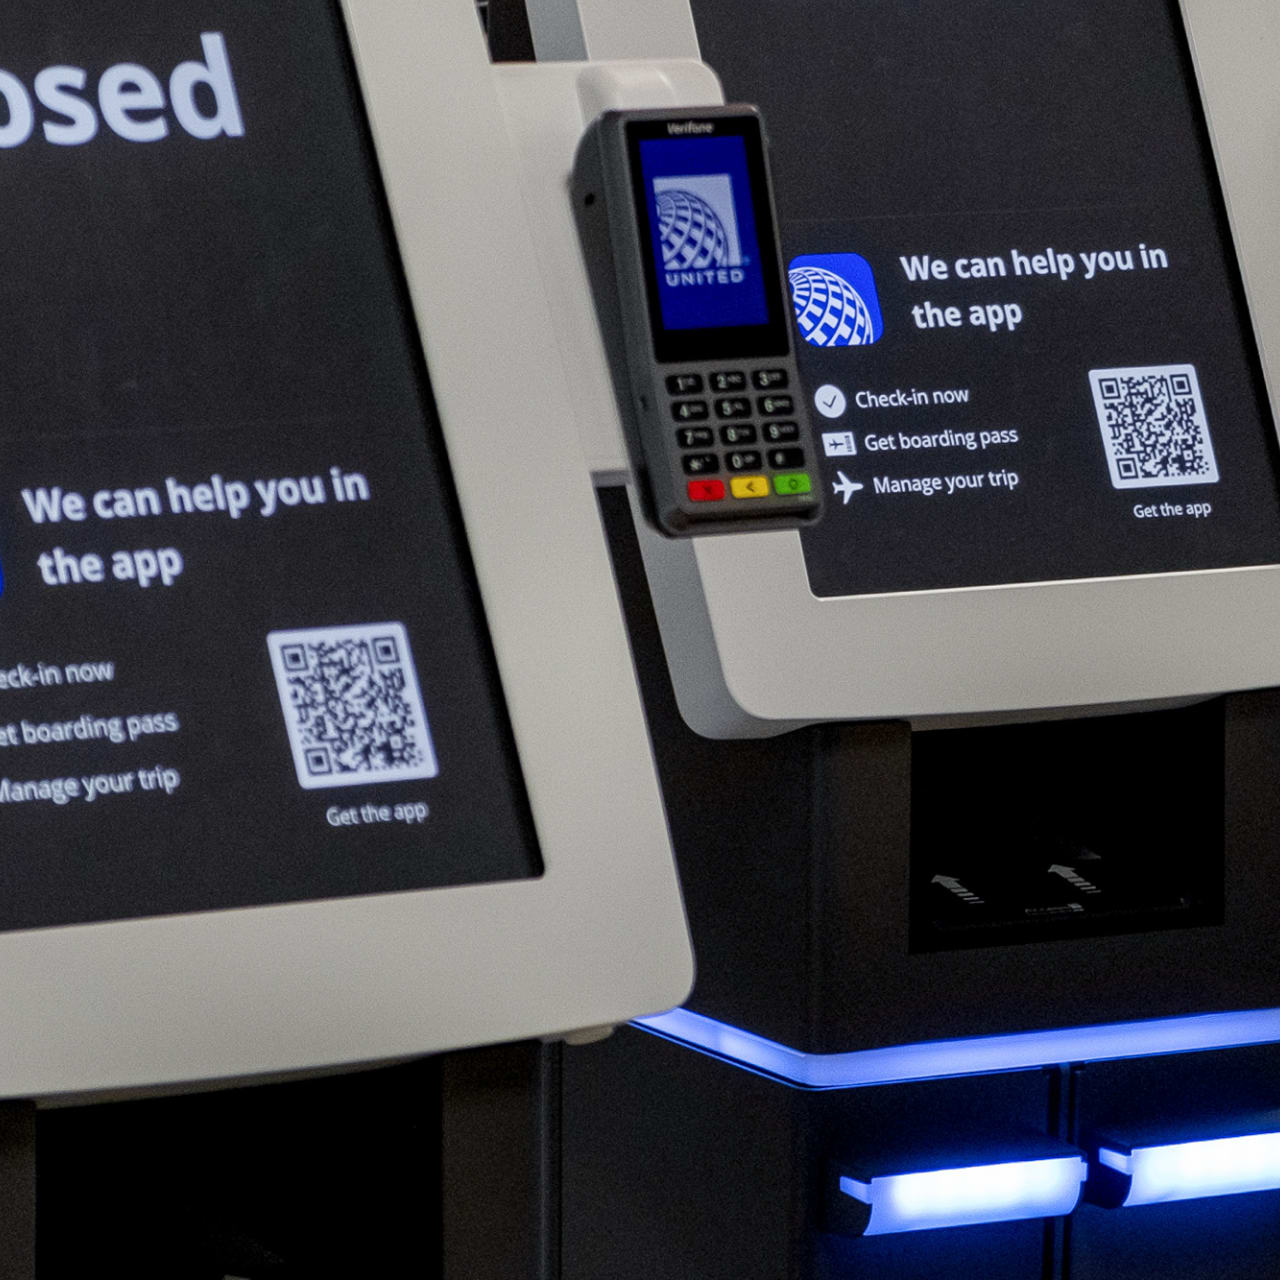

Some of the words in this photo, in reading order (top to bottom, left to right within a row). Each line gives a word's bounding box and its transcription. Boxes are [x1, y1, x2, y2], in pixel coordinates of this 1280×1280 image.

[667, 121, 713, 136] Verifone
[899, 254, 949, 282] We
[954, 256, 1007, 279] can
[1010, 247, 1076, 281] help
[1079, 250, 1135, 280] you
[1138, 243, 1169, 270] in
[665, 268, 745, 288] UNITED
[911, 300, 963, 329] the
[968, 303, 1023, 333] app
[676, 376, 685, 391] 1
[717, 374, 728, 389] 2
[759, 371, 769, 386] 3
[855, 388, 929, 409] Check-in
[932, 389, 970, 405] now
[864, 433, 897, 452] Get
[898, 429, 978, 451] boarding
[979, 429, 1019, 450] pass
[20, 486, 88, 524] We
[92, 487, 163, 520] can
[164, 473, 251, 520] help
[253, 475, 327, 517] you
[329, 466, 371, 502] in
[872, 475, 943, 497] Manage
[944, 473, 985, 495] your
[987, 468, 1020, 491] trip
[1133, 504, 1160, 519] Get
[1159, 501, 1184, 517] the
[1185, 502, 1212, 519] app
[36, 546, 105, 586] the
[111, 547, 184, 588] app
[64, 661, 115, 684] now
[20, 714, 126, 745] boarding
[125, 712, 180, 742] pass
[80, 771, 135, 803] your
[137, 765, 181, 795] trip
[325, 806, 361, 827] Get
[359, 803, 393, 824] the
[393, 801, 429, 824] app
